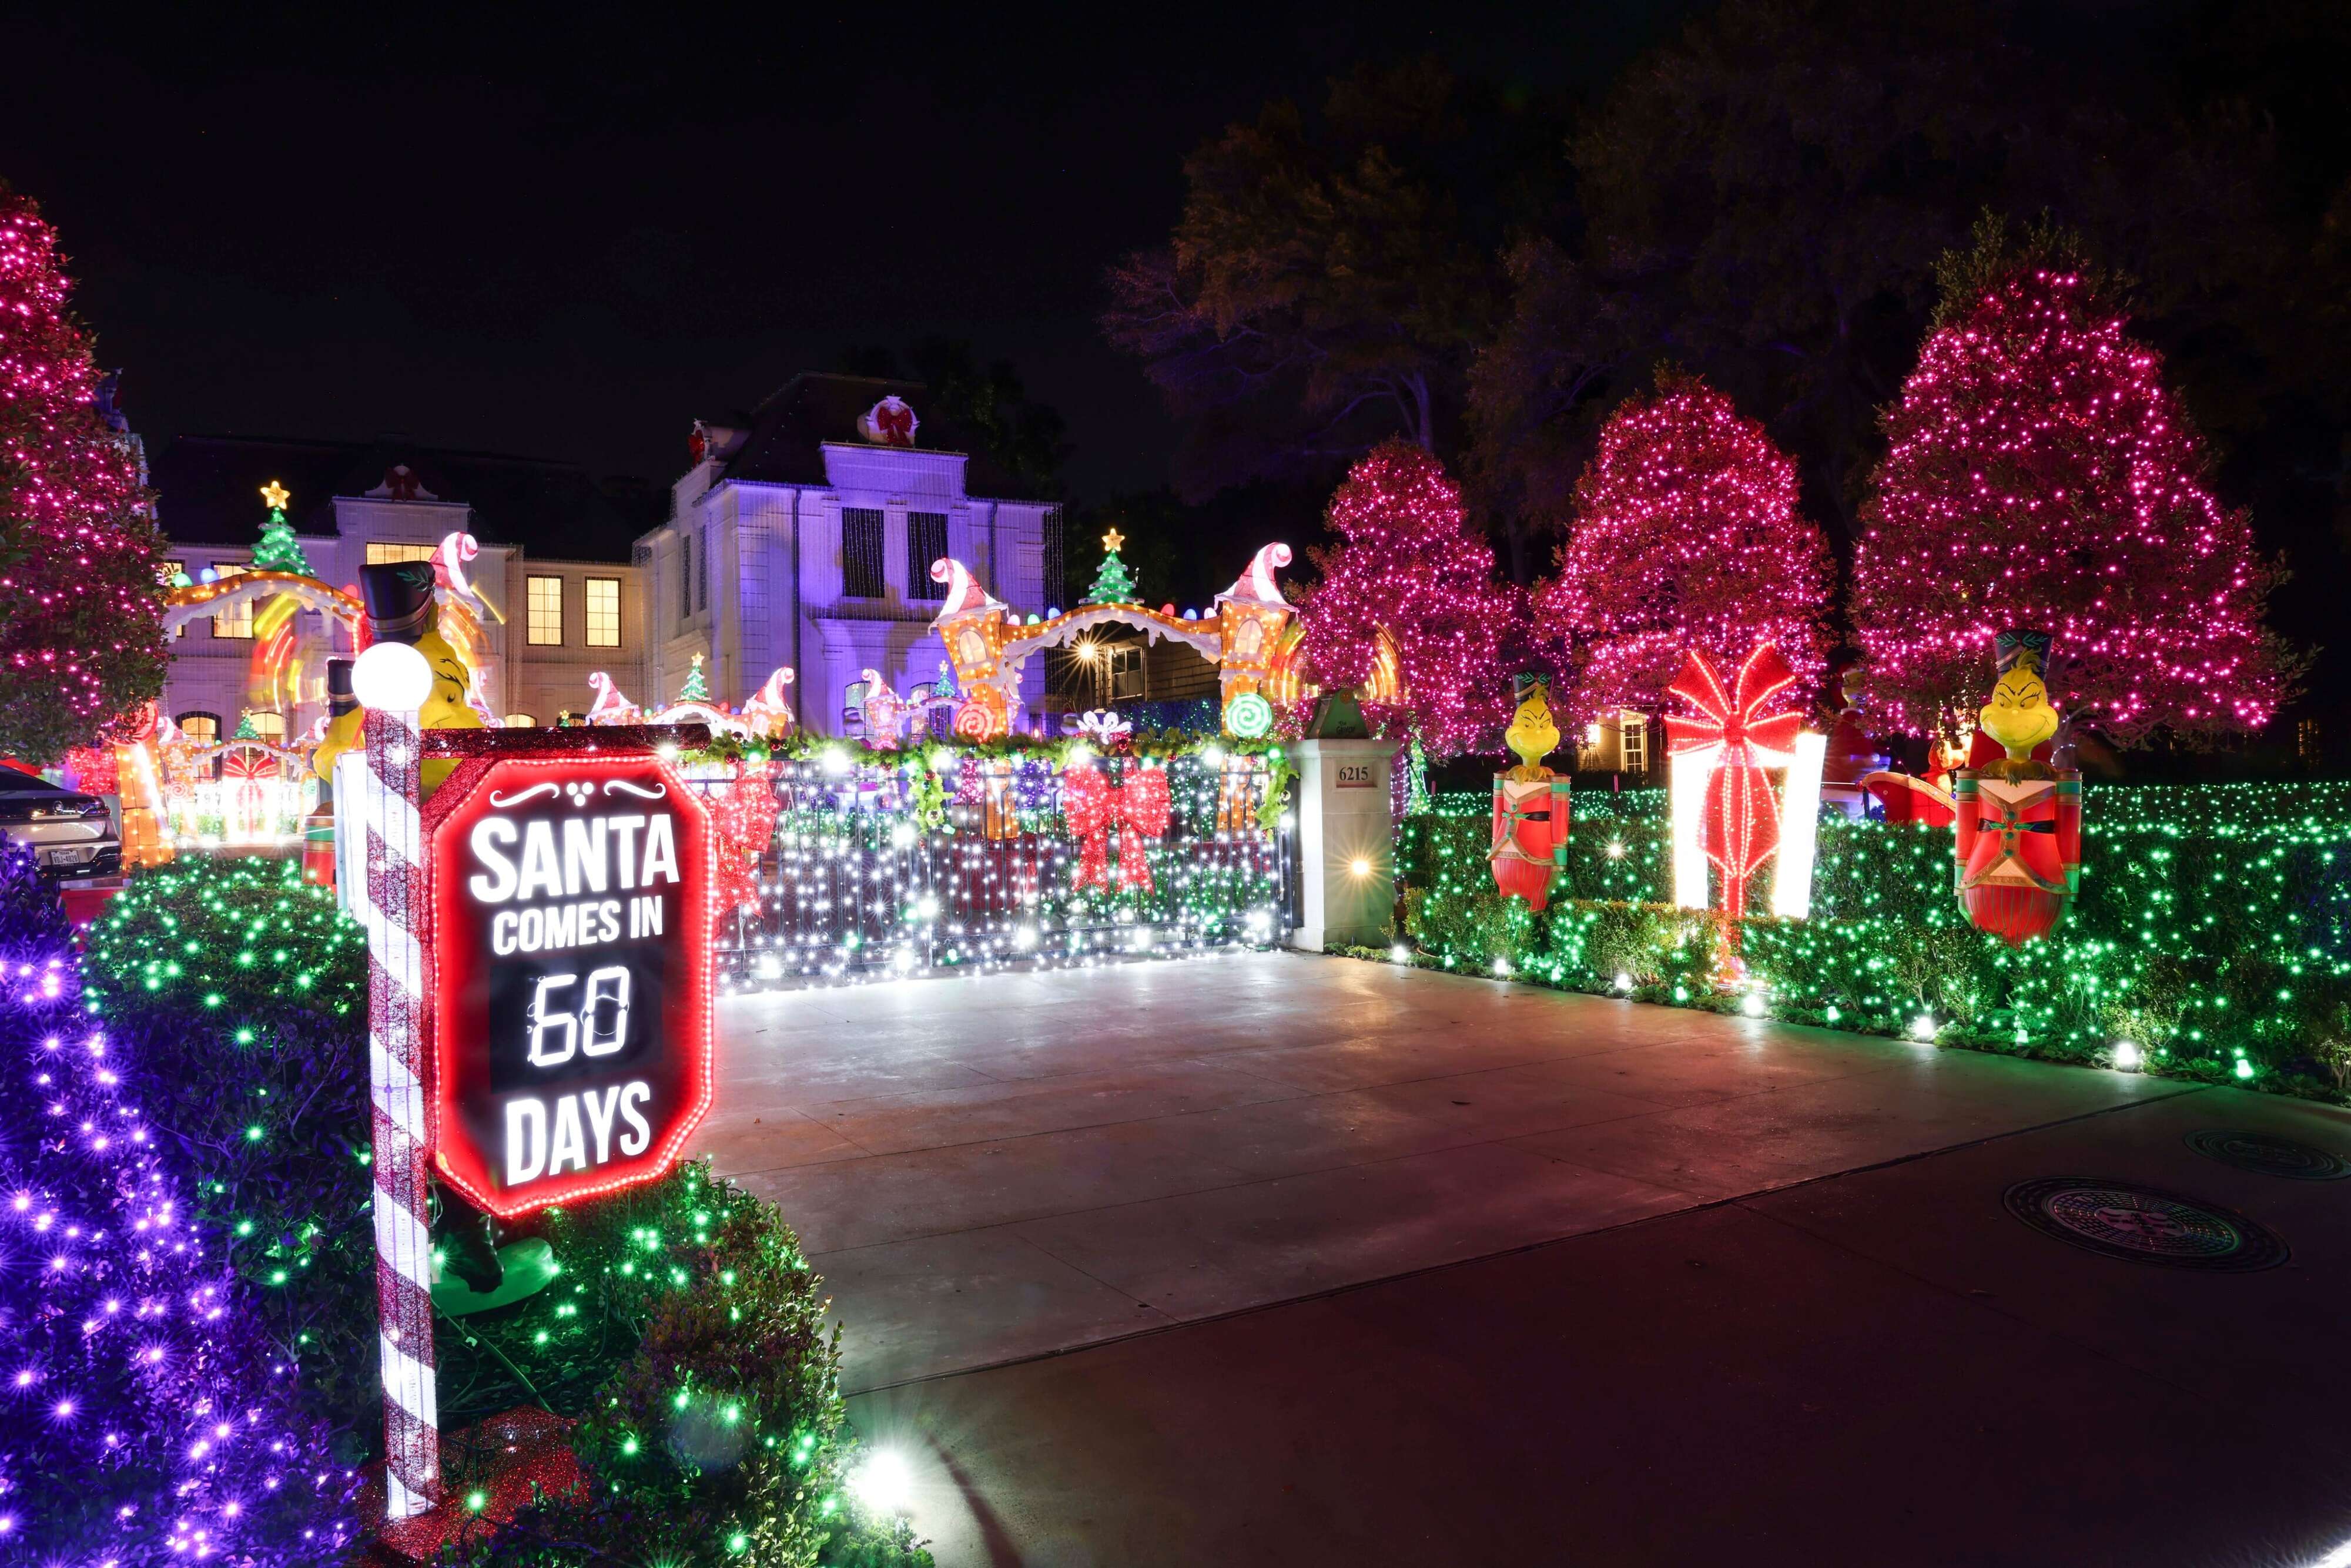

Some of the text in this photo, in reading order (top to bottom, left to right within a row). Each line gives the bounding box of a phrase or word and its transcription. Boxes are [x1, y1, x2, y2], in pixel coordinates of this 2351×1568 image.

[1339, 767, 1368, 780] 6215
[470, 813, 680, 903] SANTA
[493, 896, 663, 956] COMES IN
[529, 966, 631, 1067] 60
[506, 1081, 651, 1186] DAYS
